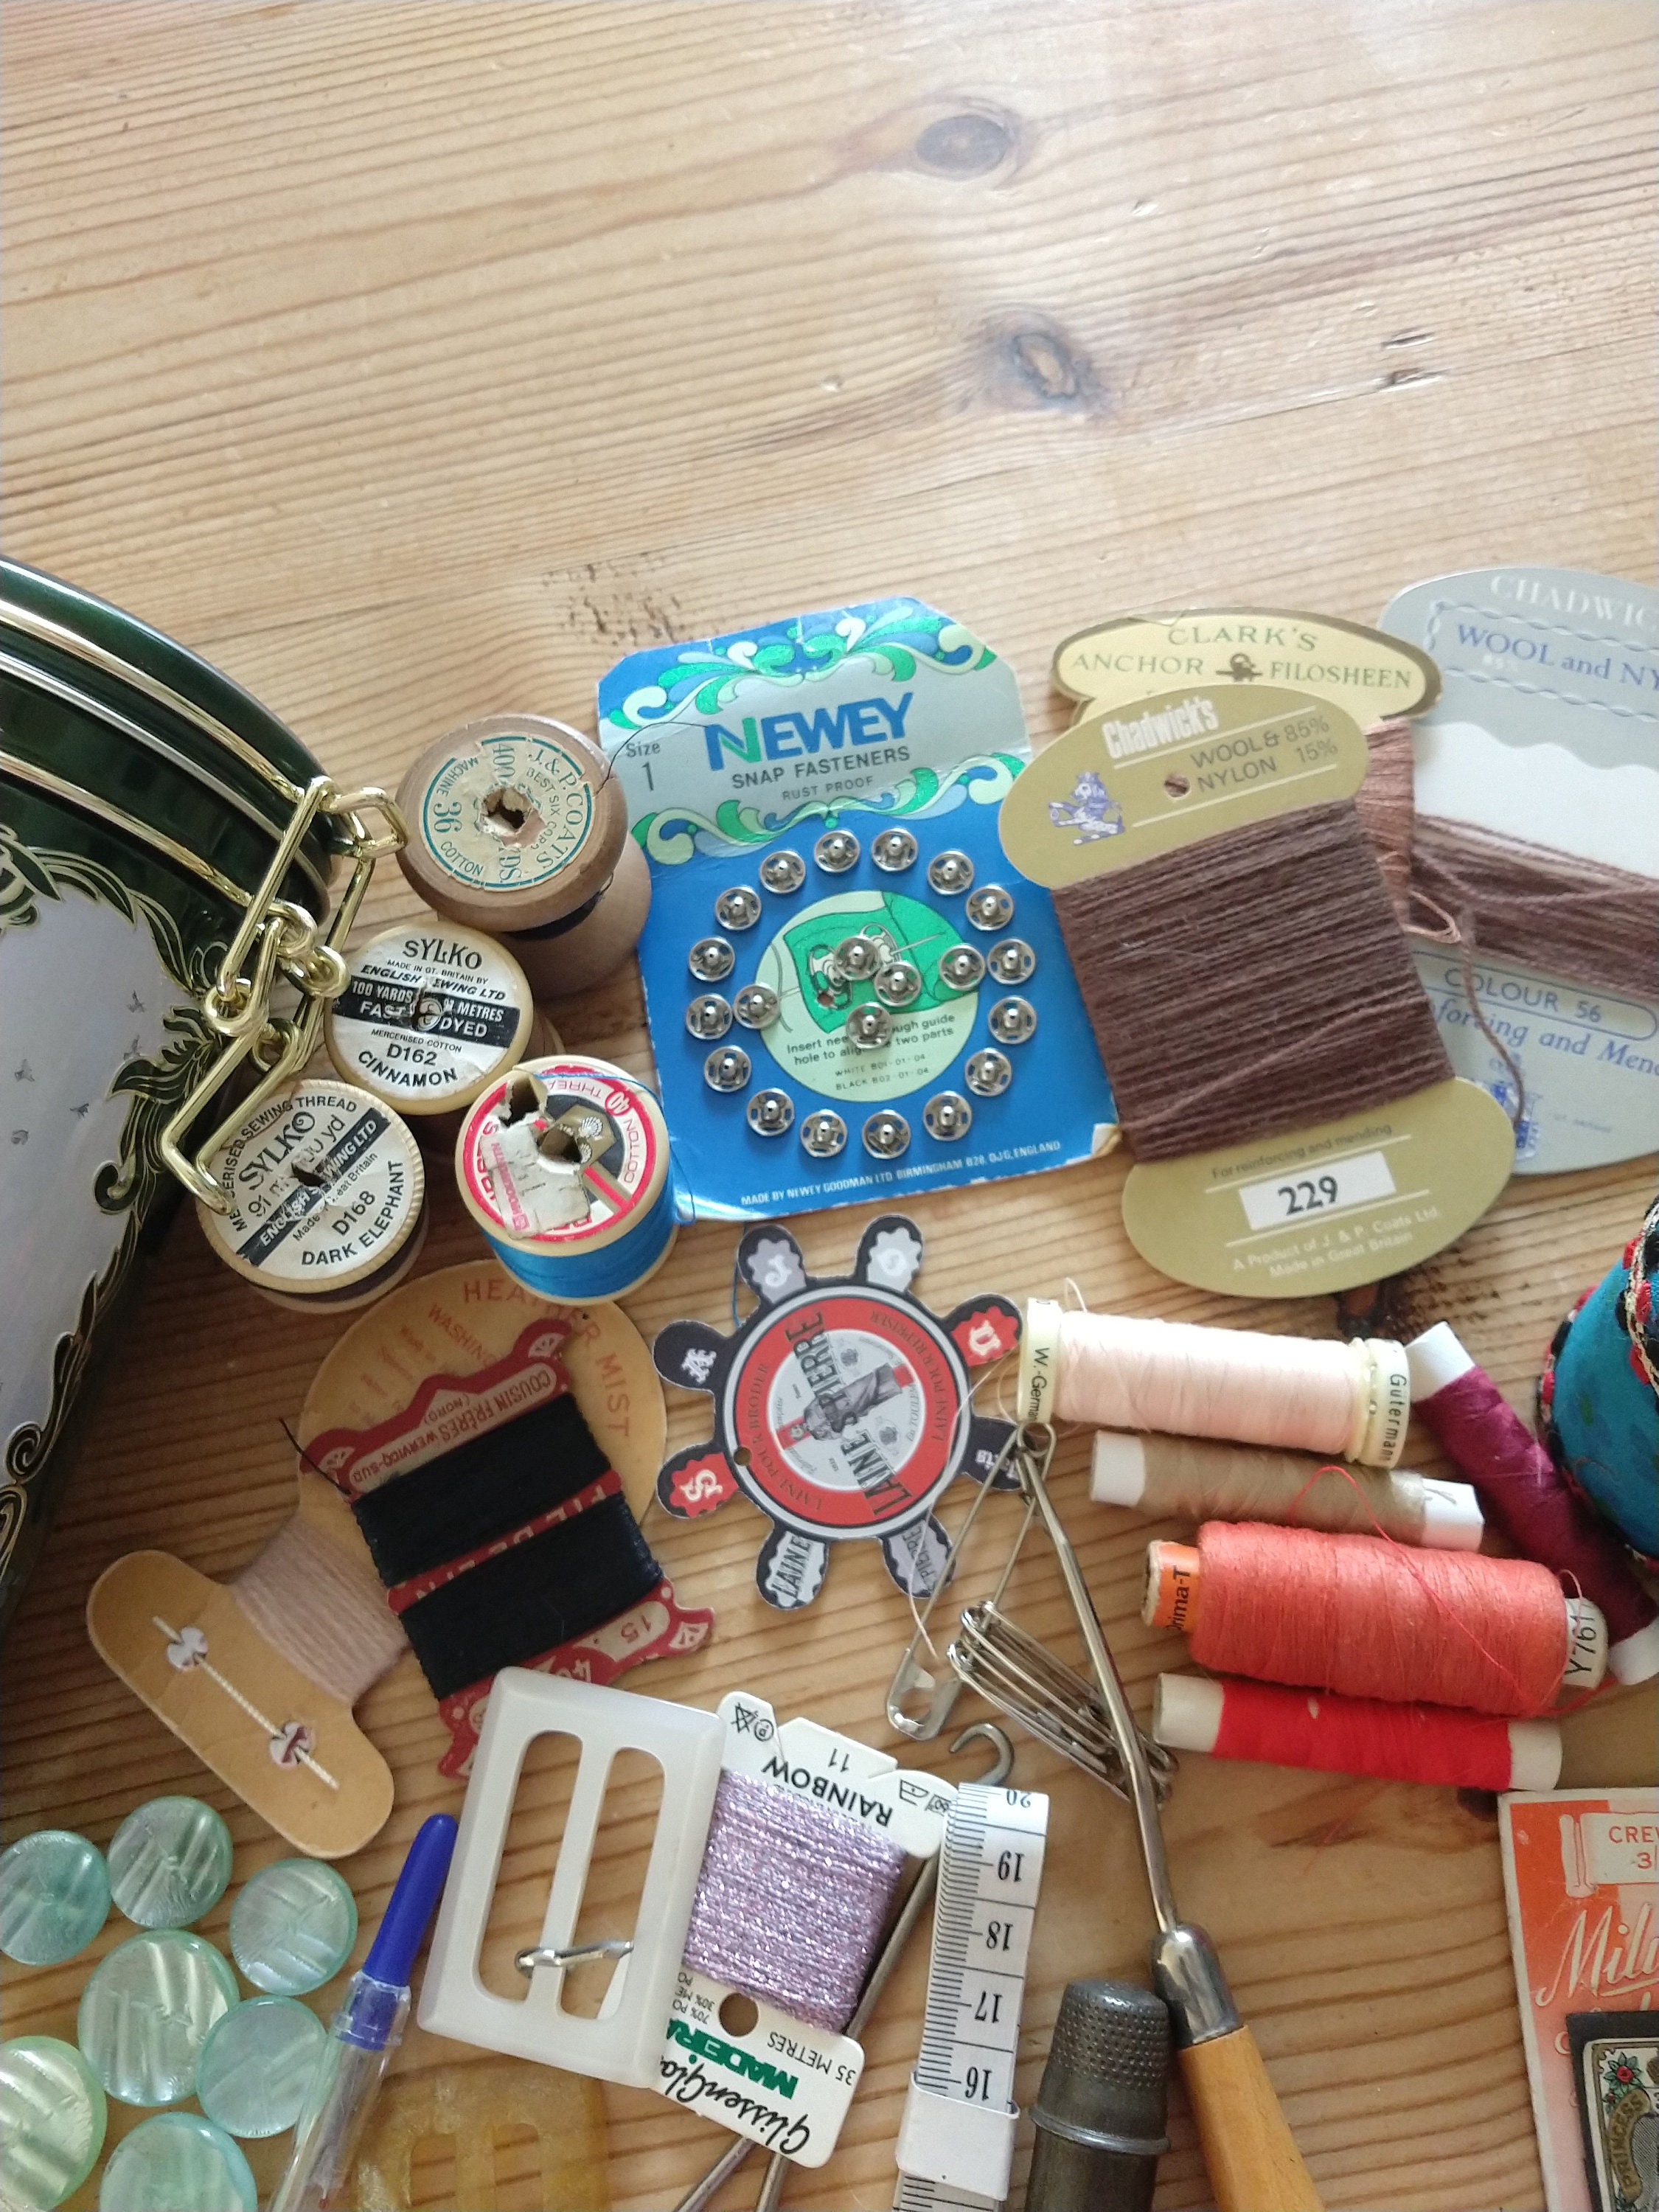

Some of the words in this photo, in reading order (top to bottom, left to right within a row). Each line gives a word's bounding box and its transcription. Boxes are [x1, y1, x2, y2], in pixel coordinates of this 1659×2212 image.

[1490, 575, 1659, 632] CHADWIC
[1168, 625, 1318, 653] CLARK'S
[1458, 625, 1554, 666] WOOL
[1561, 655, 1612, 680] and
[1073, 653, 1204, 675] ANCHOR
[1270, 661, 1413, 689] FILOSHEEN
[705, 692, 914, 771] NEWEY
[1102, 695, 1220, 760] Chadwick's
[1190, 739, 1262, 769] WOOL
[1283, 717, 1331, 745] 85%
[545, 758, 560, 775] &
[626, 740, 661, 758] Size
[732, 767, 785, 789] SNAP
[795, 746, 911, 779] FASTENERS
[1197, 756, 1278, 793] NYLON
[1295, 740, 1339, 765] 15%
[437, 757, 479, 797] MACHINE
[526, 767, 556, 793] BEST
[549, 796, 560, 816] SIX
[644, 761, 655, 791] 1
[782, 785, 819, 801] RUST
[825, 775, 874, 793] PROOF
[433, 801, 462, 833] 36
[536, 793, 585, 869] COATS
[441, 841, 484, 876] COTTON
[387, 959, 411, 970] MADE
[414, 964, 422, 972] IN
[441, 969, 473, 984] BRITAIN
[476, 977, 489, 985] BY
[403, 938, 482, 970] SYLKO
[352, 981, 373, 997] 100
[376, 984, 414, 1004] YARDS
[457, 1000, 504, 1023] METRES
[361, 964, 422, 984] ENGLISH
[431, 978, 477, 995] EWING
[479, 987, 507, 1001] LTD
[1444, 967, 1560, 1012] COLOUR
[1575, 1001, 1602, 1023] 56
[371, 1028, 425, 1045] MERCERISED
[427, 1039, 462, 1053] COTTON
[439, 1016, 488, 1038] DYED
[787, 1039, 822, 1054] Insert
[922, 1014, 956, 1029] guide
[794, 1053, 820, 1065] hole
[824, 1051, 835, 1060] to
[841, 1046, 867, 1056] alig
[896, 1036, 919, 1046] two
[922, 1027, 954, 1042] parts
[1539, 1032, 1590, 1055] and
[358, 1050, 459, 1088] CINNAMON
[386, 1043, 438, 1066] D162
[321, 1113, 346, 1143] yd
[353, 1120, 378, 1150] LTD
[222, 1138, 248, 1233] MEERISED
[240, 1099, 294, 1139] SEWING
[295, 1096, 358, 1113] THREAD
[238, 1110, 316, 1191] SYLKO
[623, 1119, 639, 1184] COTTON
[1212, 1166, 1234, 1178] For
[1236, 1146, 1306, 1171] reinforcing
[1309, 1140, 1332, 1155] and
[1335, 1124, 1392, 1146] mending
[741, 1192, 770, 1206] MADE
[772, 1190, 785, 1201] BY
[787, 1183, 821, 1199] NEWEY
[823, 1175, 873, 1193] GOODMAN
[897, 1158, 962, 1180] BIRMINGHAM
[1015, 1141, 1060, 1158] ENGLAND
[292, 1213, 321, 1242] Made
[347, 1152, 378, 1186] Britain
[301, 1242, 358, 1265] DARK
[359, 1161, 405, 1248] ELEPHANT
[331, 1189, 376, 1236] D168
[1278, 1175, 1338, 1216] 229
[1233, 1259, 1245, 1270] A
[1248, 1245, 1300, 1266] Product
[1372, 1214, 1412, 1234] Coats
[1269, 1259, 1308, 1278] Made
[1367, 1231, 1413, 1251] Britain
[495, 1369, 552, 1411] COUSIN
[595, 1352, 631, 1437] MIST
[838, 1428, 914, 1516] LAINE
[768, 1534, 811, 1599] LAINE
[620, 1613, 653, 1644] 15
[827, 1748, 850, 1773] 11
[761, 1756, 894, 1828] RAINBOW
[1006, 1788, 1032, 1809] 20
[997, 1851, 1024, 1882] 19
[985, 1920, 1015, 1951] 18
[690, 2010, 710, 2025] 70%
[973, 1993, 1003, 2024] 17
[767, 2031, 832, 2074] METRES
[835, 2065, 856, 2087] 35
[963, 2065, 993, 2101] 16
